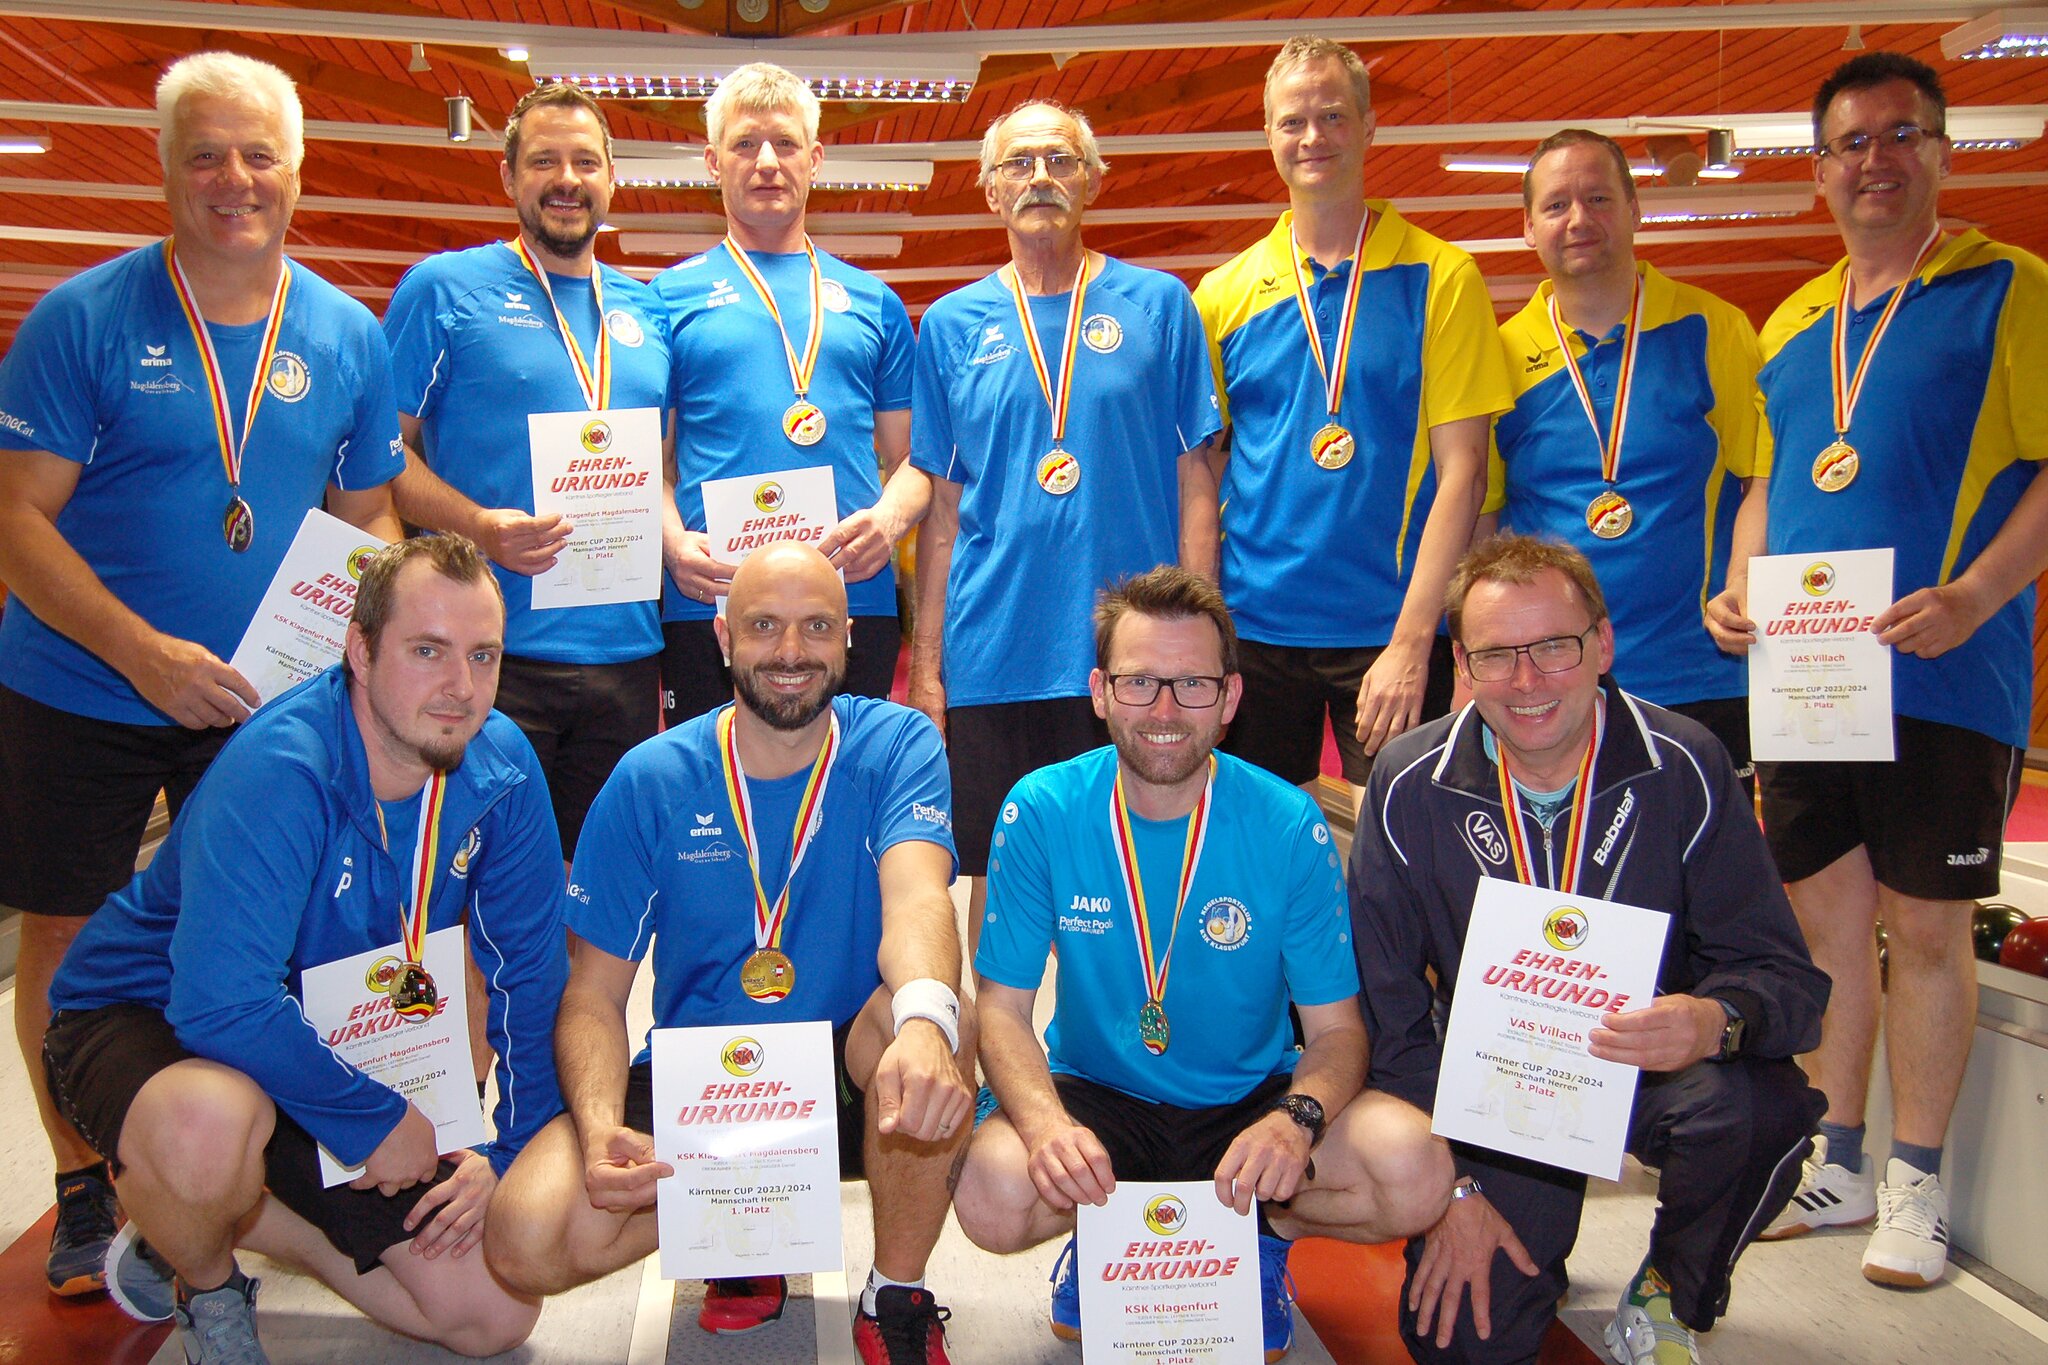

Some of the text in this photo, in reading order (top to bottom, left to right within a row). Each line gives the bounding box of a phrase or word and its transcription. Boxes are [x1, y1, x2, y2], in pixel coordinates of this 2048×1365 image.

[141, 357, 173, 367] erima
[1526, 361, 1549, 373] erima
[567, 456, 632, 473] EHREN-
[550, 471, 649, 493] URKUNDE
[565, 511, 600, 520] Klagenfurt
[601, 507, 650, 517] Magdalensberg
[741, 513, 806, 533] EHREN-
[605, 534, 643, 544] 2023/2024
[572, 545, 607, 553] Mannschaft
[316, 572, 358, 600] EHR
[290, 580, 354, 619] URKU
[1783, 600, 1856, 616] EHREN-
[273, 614, 289, 625] KSK
[289, 620, 325, 641] Klagenfurt
[1765, 616, 1875, 636] URKUNDE
[265, 645, 298, 663] Kärntner
[298, 659, 314, 669] CUP
[1790, 654, 1846, 663] VAS Villach
[278, 660, 312, 678] Mannschaft
[1771, 686, 1804, 694] Kärntner
[1824, 685, 1868, 693] 2023/2024
[690, 826, 722, 837] erima
[1592, 787, 1636, 866] Babolat
[1472, 816, 1503, 860] VAS
[677, 848, 731, 862] Magdalensberg
[1946, 854, 1983, 866] JAKO
[1070, 895, 1111, 913] JAKO
[1059, 915, 1092, 928] Perfect
[1510, 949, 1608, 981] EHREN-
[1482, 965, 1631, 1014] URKUNDE
[1510, 1016, 1536, 1032] VAS
[1539, 1023, 1582, 1043] Villach
[353, 1055, 388, 1069] agenfurt
[390, 1036, 450, 1058] Magdalensberg
[1475, 1050, 1604, 1088] Kärntner CUP 2023/2024
[399, 1069, 447, 1089] 2023/2024
[1496, 1066, 1578, 1092] Mannschaft Herren
[403, 1084, 429, 1096] Herren
[700, 1081, 792, 1101] EHREN-
[1514, 1080, 1556, 1098] 3. Platz
[676, 1099, 817, 1127] URKUNDE
[688, 1184, 812, 1196] Kärntner CUP 2023/2024
[711, 1195, 790, 1205] Mannschaft Herren
[731, 1206, 770, 1215] 1. Platz
[1124, 1239, 1216, 1258] EHREN-
[1101, 1256, 1240, 1282] URKUNDE
[1125, 1301, 1219, 1314] KSK Klagenfurt
[1113, 1336, 1235, 1349] Kärntner CUP 2023/2024
[1135, 1348, 1182, 1357] Mannschaft
[1169, 1357, 1194, 1365] Platz
